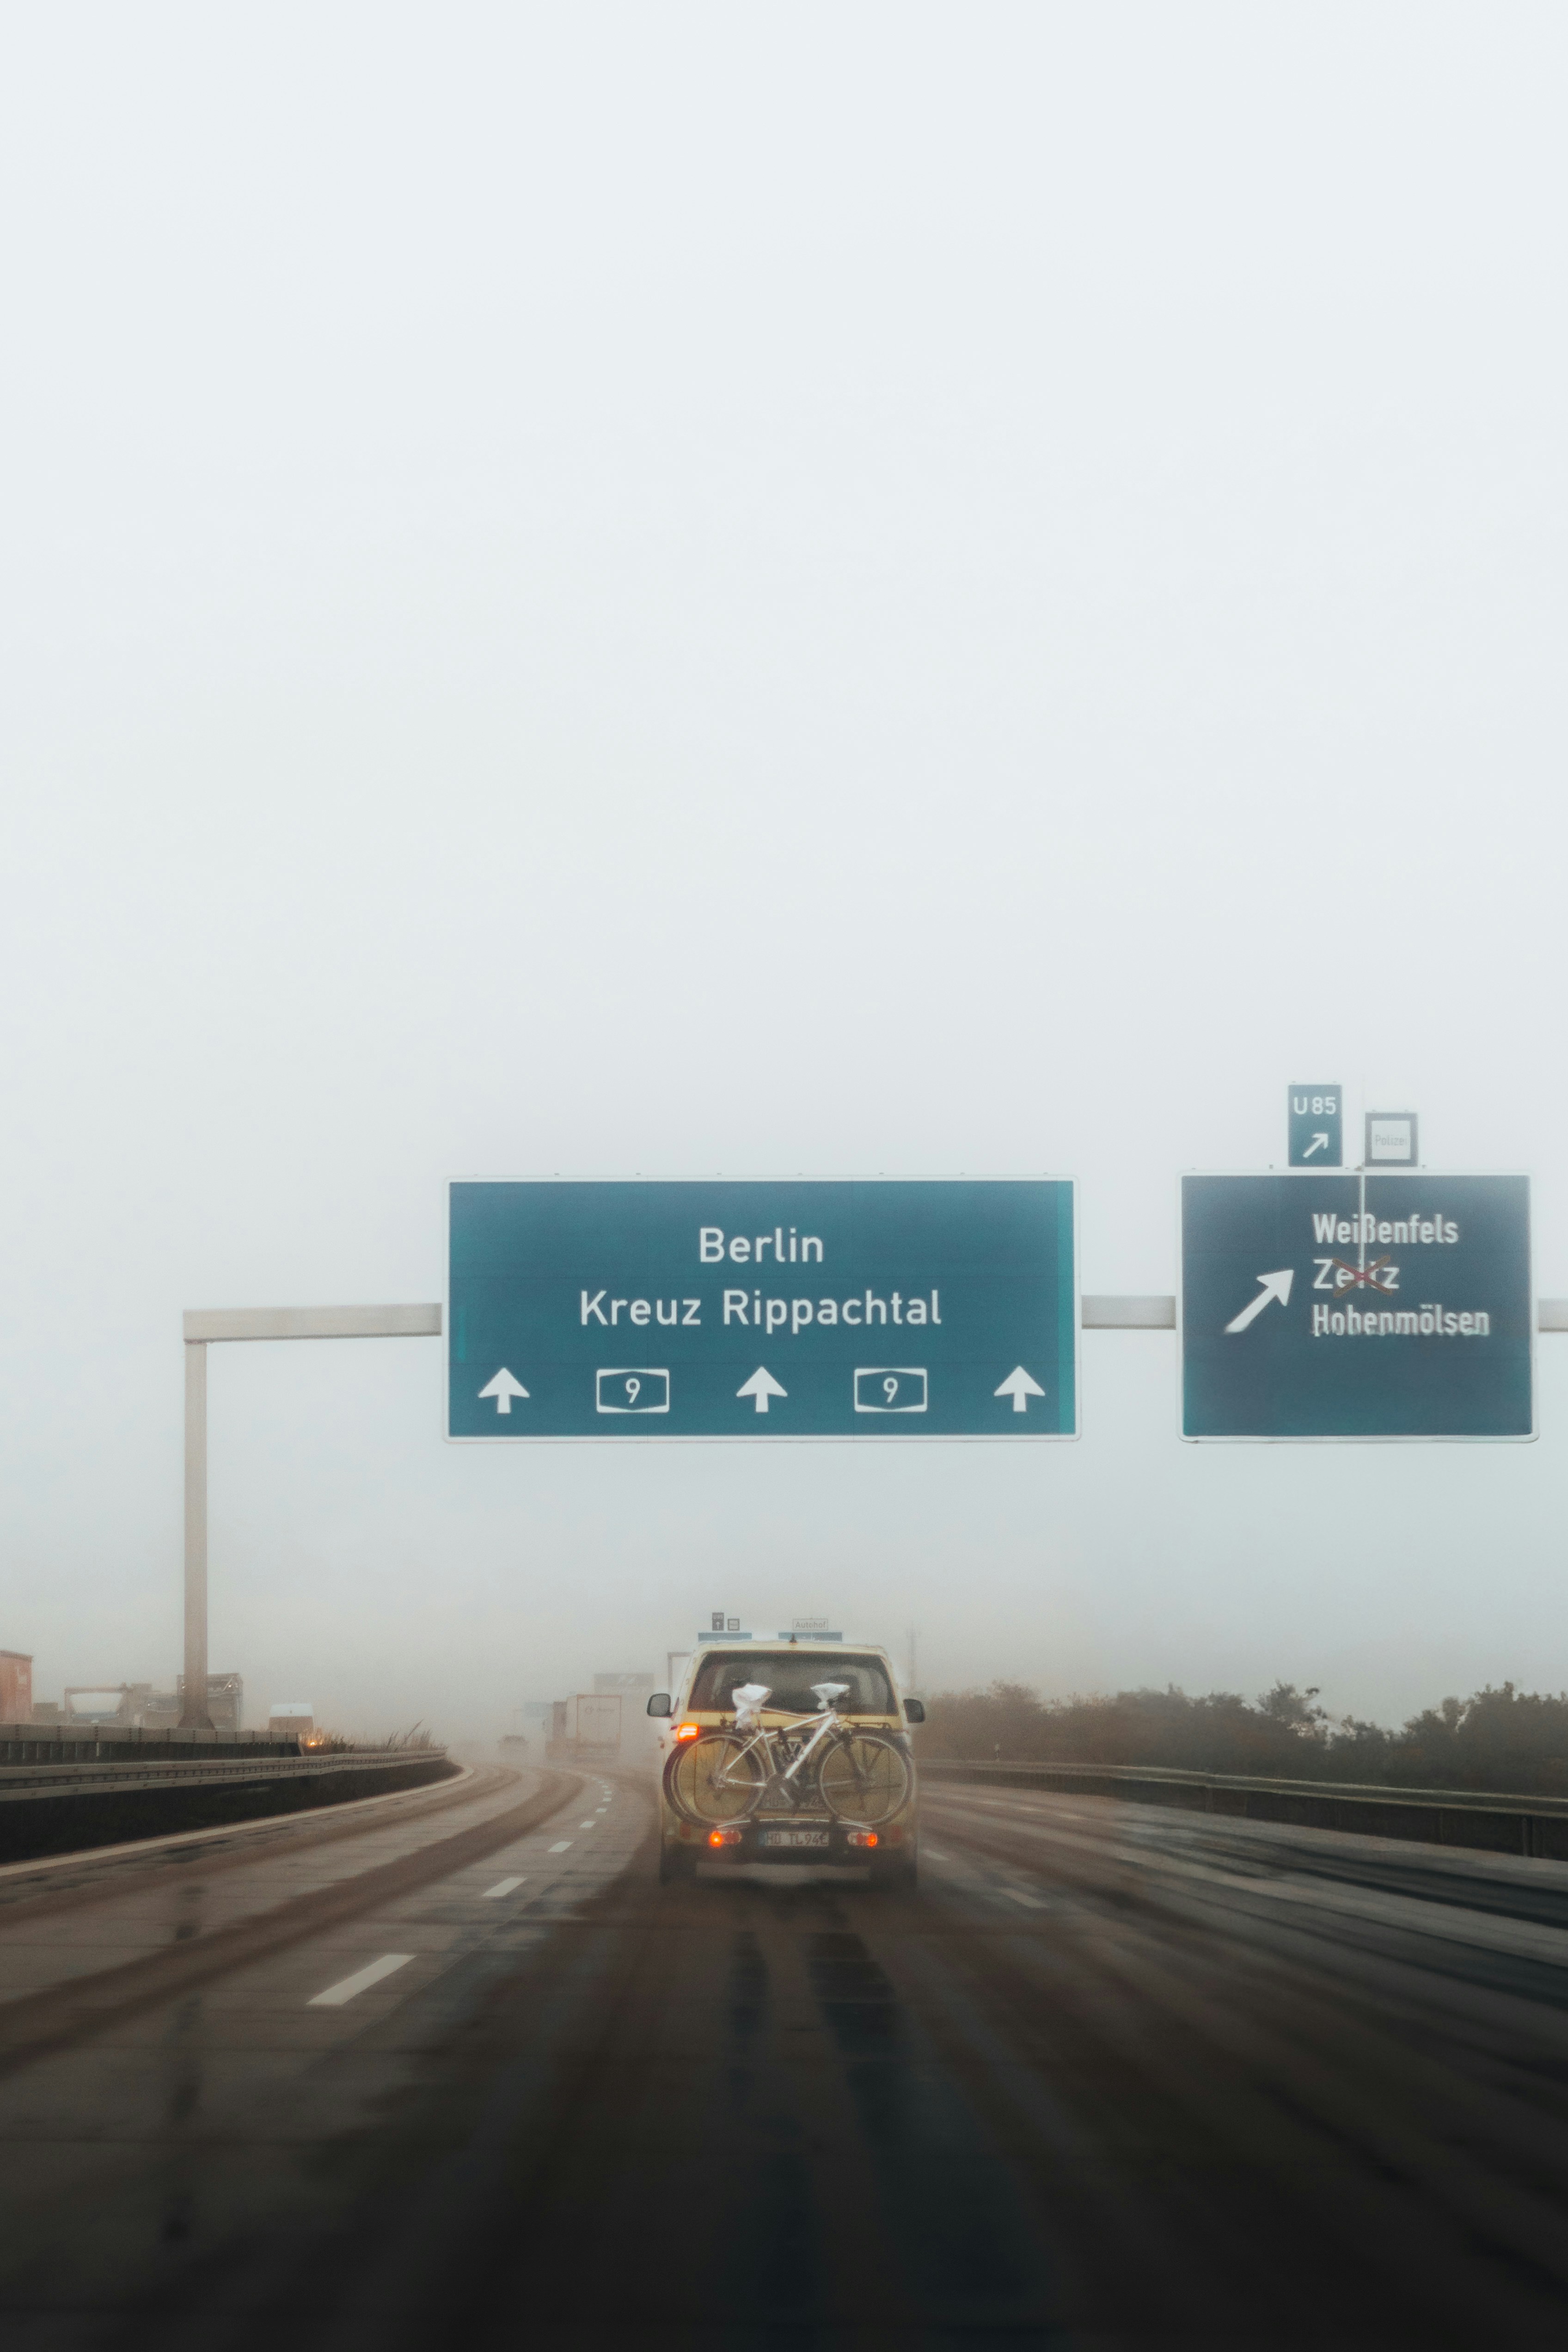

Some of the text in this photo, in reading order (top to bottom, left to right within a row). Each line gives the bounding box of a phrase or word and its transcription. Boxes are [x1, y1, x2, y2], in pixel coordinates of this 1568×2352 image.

[1374, 1134, 1408, 1146] Polizei
[1312, 1213, 1459, 1244] Weißenfels
[699, 1227, 823, 1263] Berlin
[581, 1289, 942, 1335] Kreuz Rippachtal
[1312, 1304, 1490, 1337] Hohenmölsen
[625, 1378, 641, 1404] 9
[882, 1377, 899, 1403] 9
